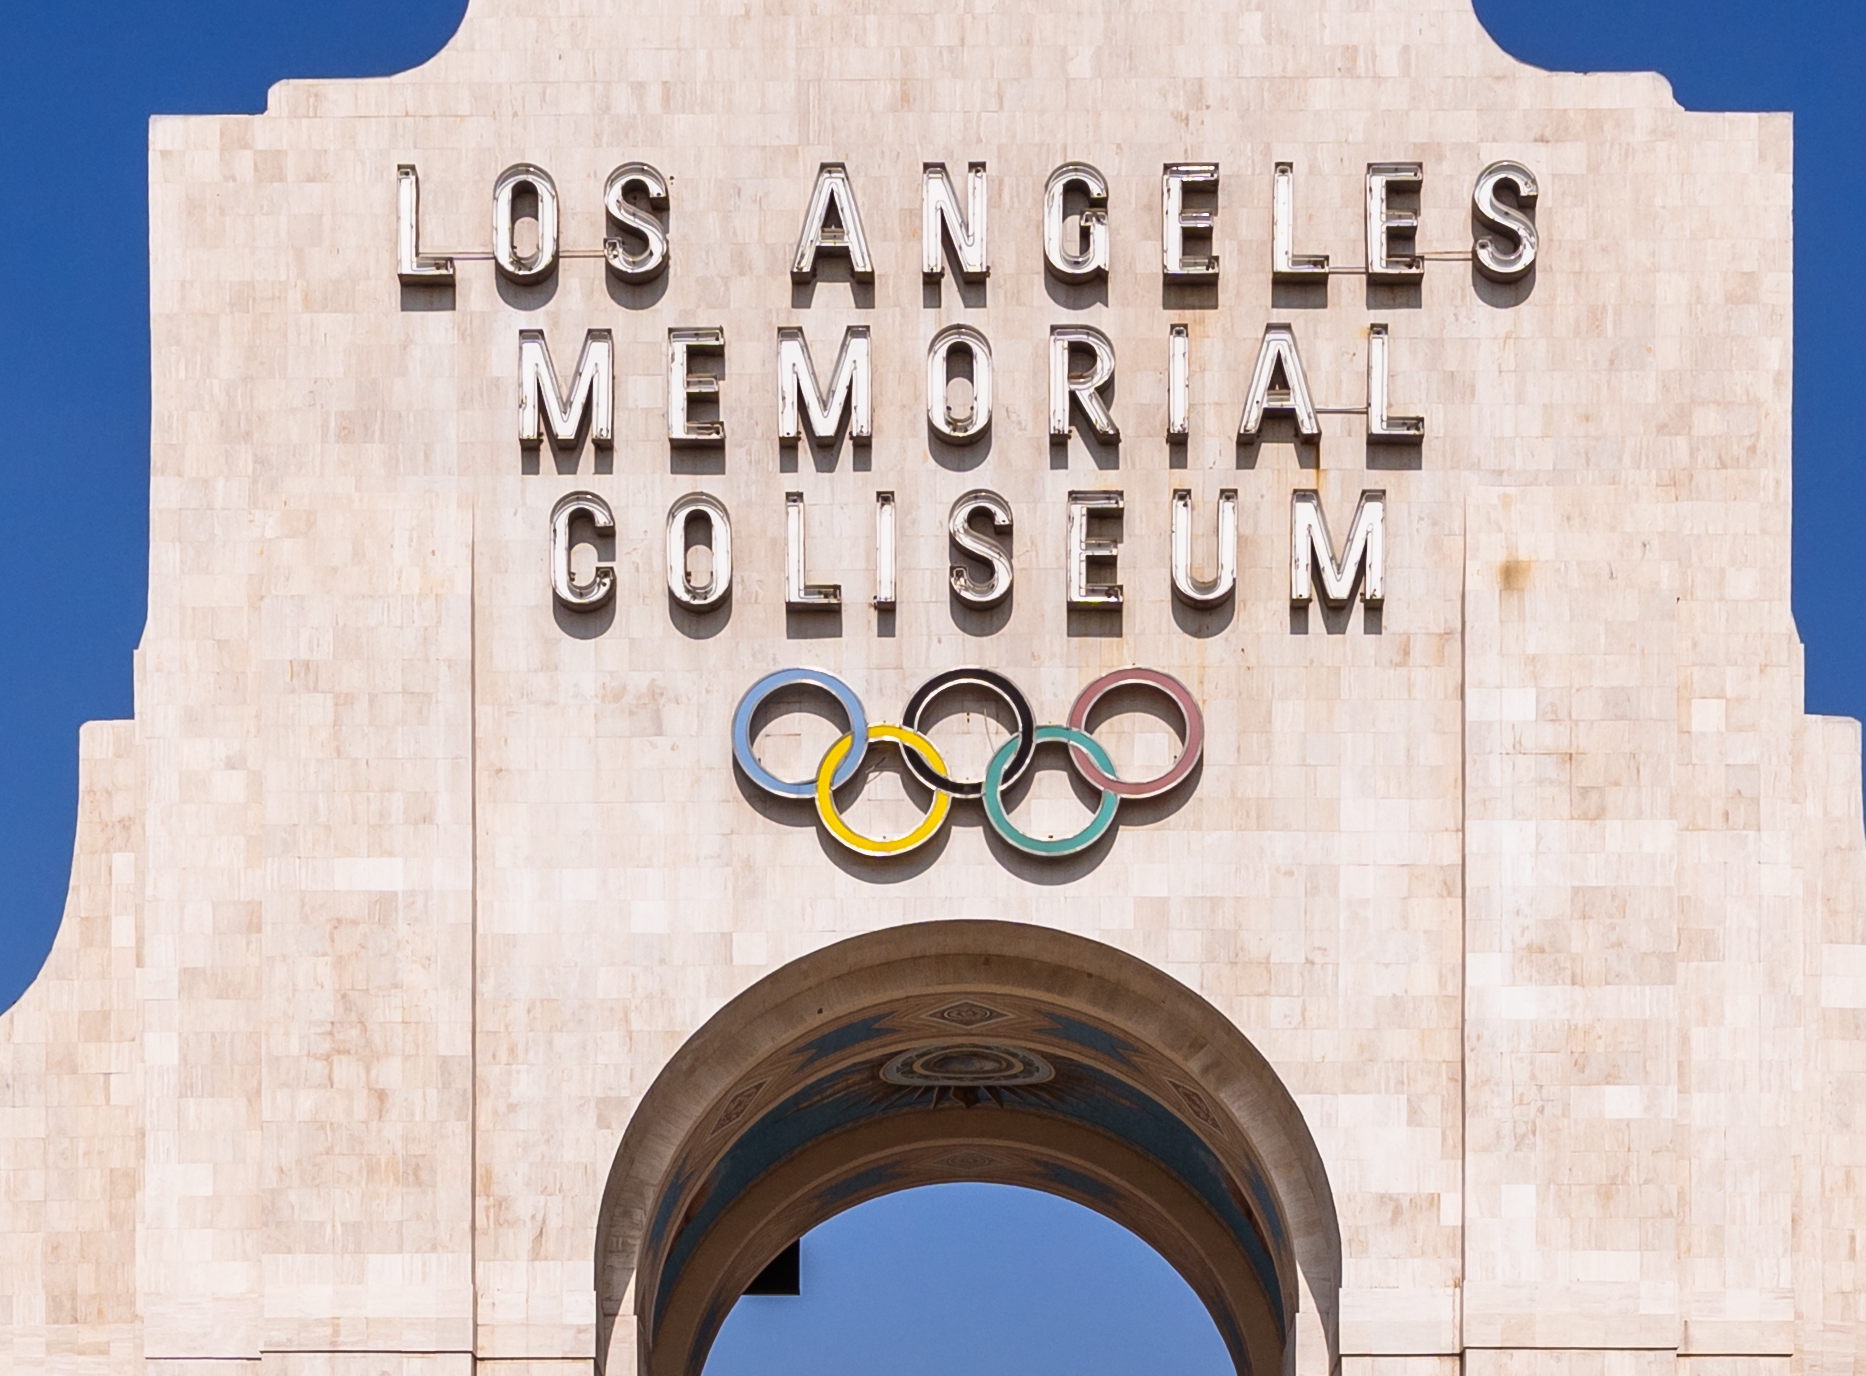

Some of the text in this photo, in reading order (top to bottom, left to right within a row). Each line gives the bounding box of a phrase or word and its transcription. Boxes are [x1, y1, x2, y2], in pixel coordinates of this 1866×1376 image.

[395, 159, 1539, 286] LOS ANGELES
[518, 322, 1426, 446] MEMORIAL
[549, 487, 1388, 613] COLISEUM
